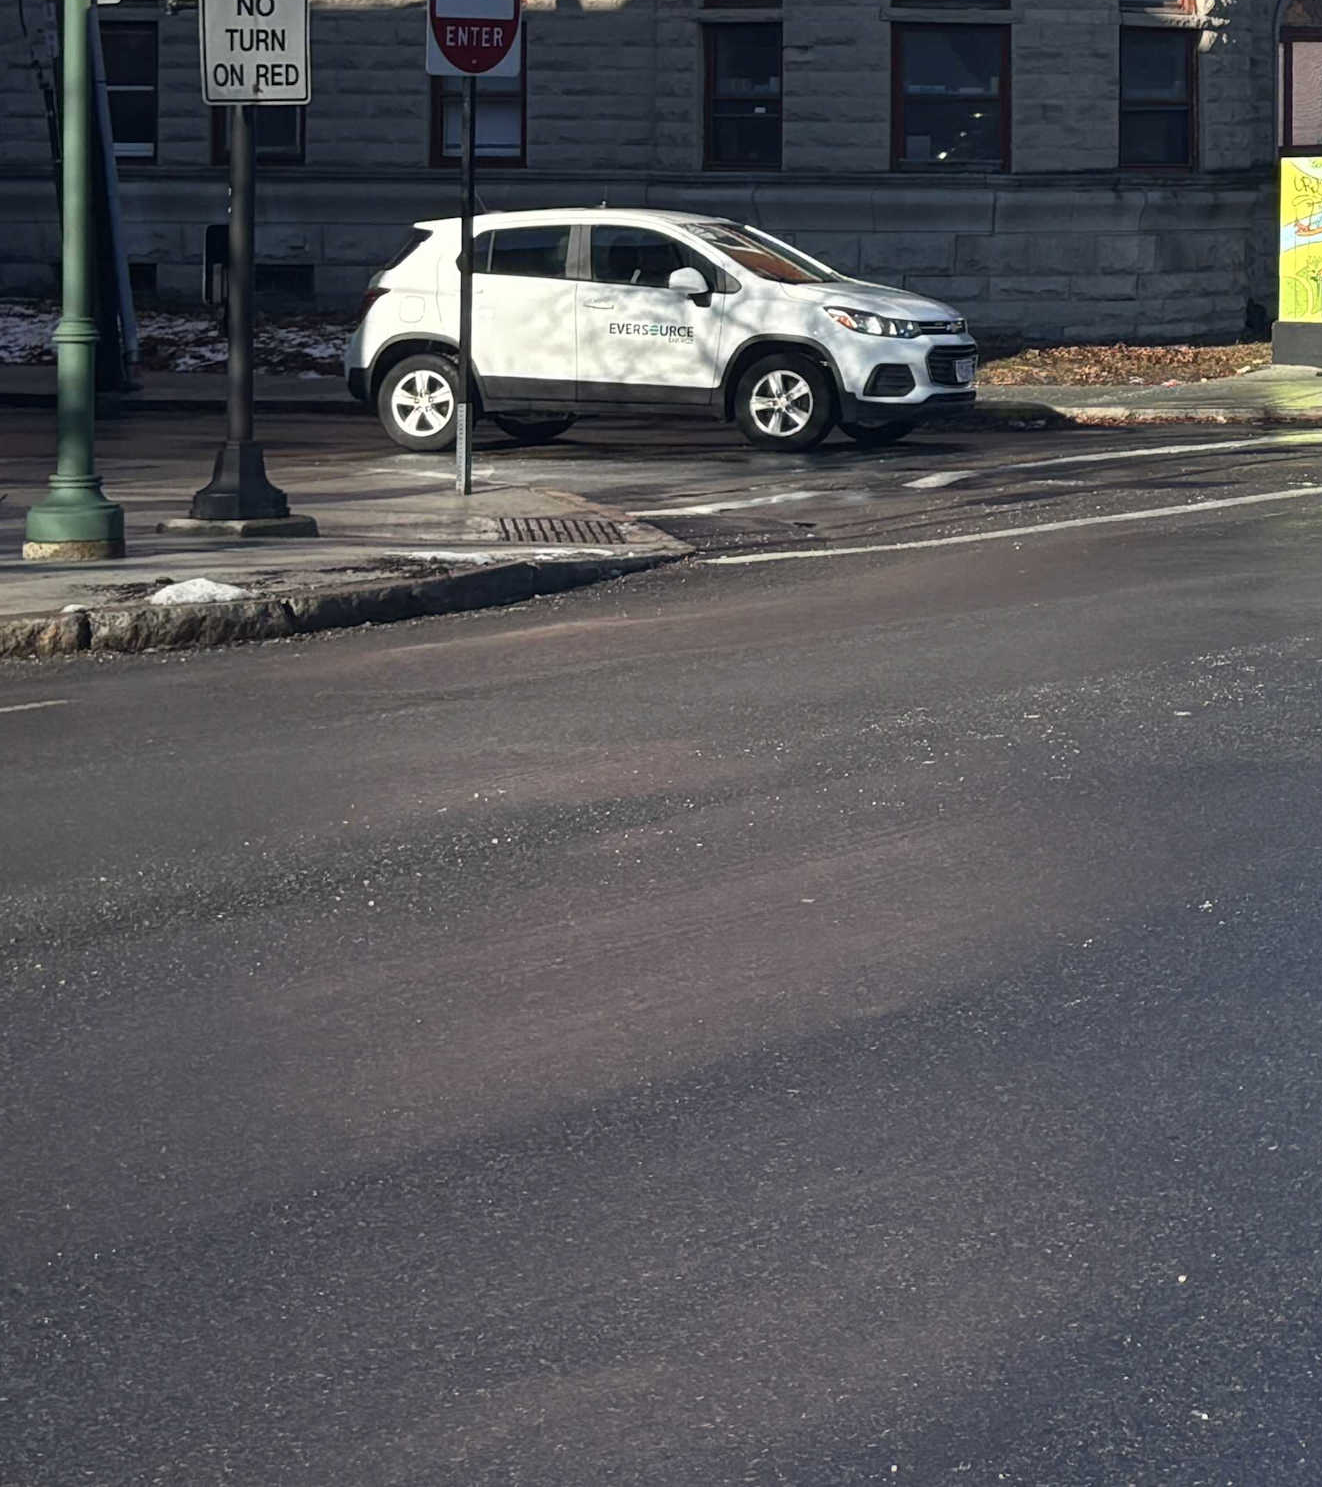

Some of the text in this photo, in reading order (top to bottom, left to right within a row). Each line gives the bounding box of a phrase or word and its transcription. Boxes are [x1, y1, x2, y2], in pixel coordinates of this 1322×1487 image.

[225, 28, 286, 52] TURN
[446, 26, 504, 47] ENTER
[213, 63, 299, 87] ON RED
[609, 322, 694, 339] EVERSOURCE
